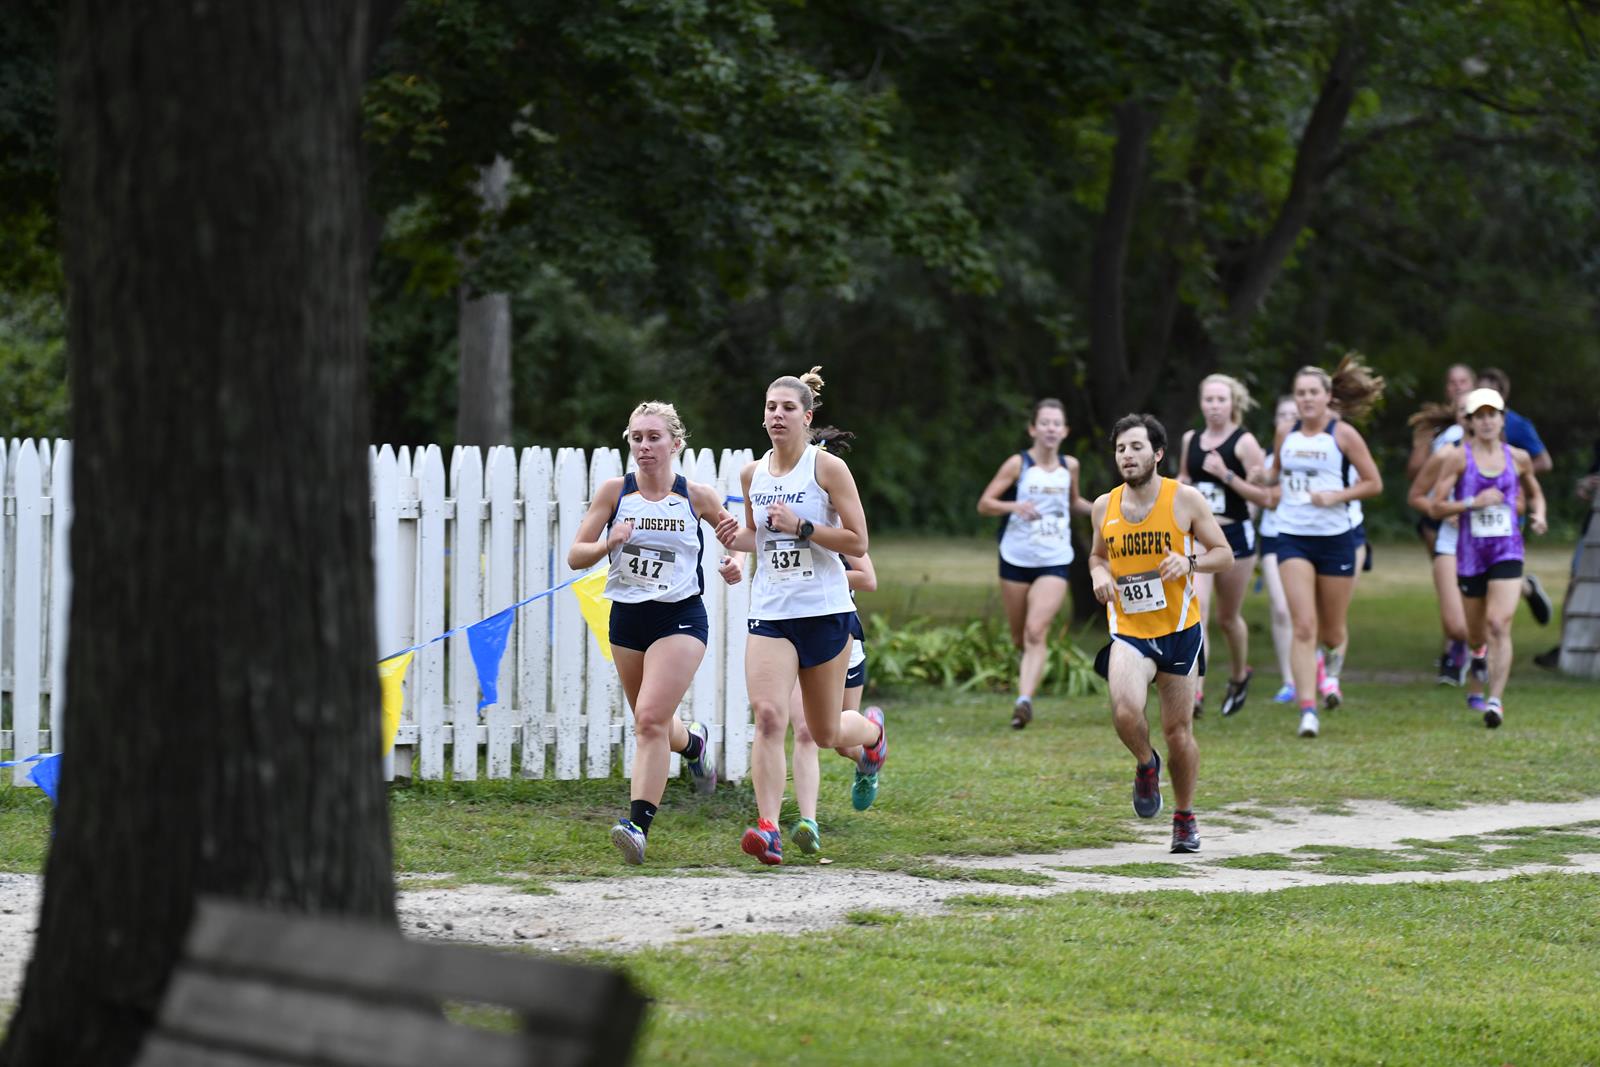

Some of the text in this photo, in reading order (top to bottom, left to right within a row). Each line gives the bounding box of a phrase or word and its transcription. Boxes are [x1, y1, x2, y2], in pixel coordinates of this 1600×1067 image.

[755, 491, 806, 506] MARITIME
[638, 518, 685, 532] JOSEPH'S
[1106, 531, 1172, 560] T. JOSEPH'S
[628, 557, 663, 579] 417
[771, 550, 801, 569] 437
[1123, 582, 1153, 601] 481
